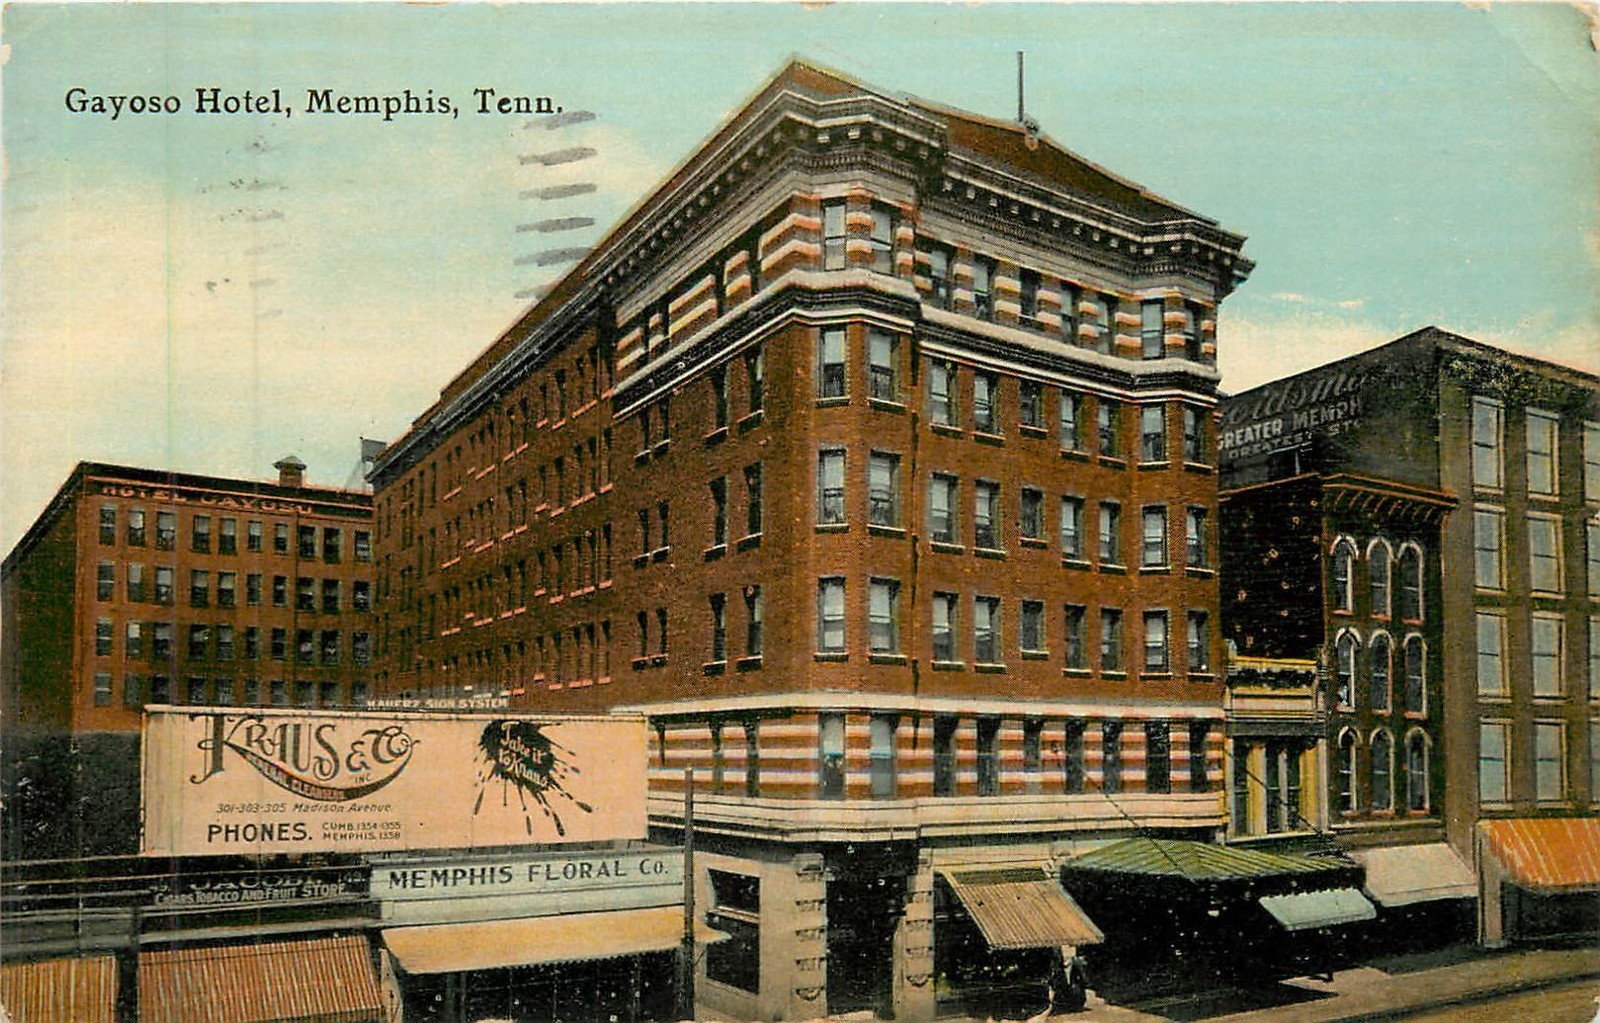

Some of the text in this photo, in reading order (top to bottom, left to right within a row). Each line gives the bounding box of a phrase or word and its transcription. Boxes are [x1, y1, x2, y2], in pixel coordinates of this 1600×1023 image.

[458, 698, 507, 708] SYSTEM
[293, 802, 344, 813] Madison
[348, 803, 392, 813] Avenue
[207, 822, 313, 843] PHONES.
[389, 866, 512, 889] MEMPHIS
[528, 859, 627, 883] FLORAL
[301, 882, 345, 897] STORE
